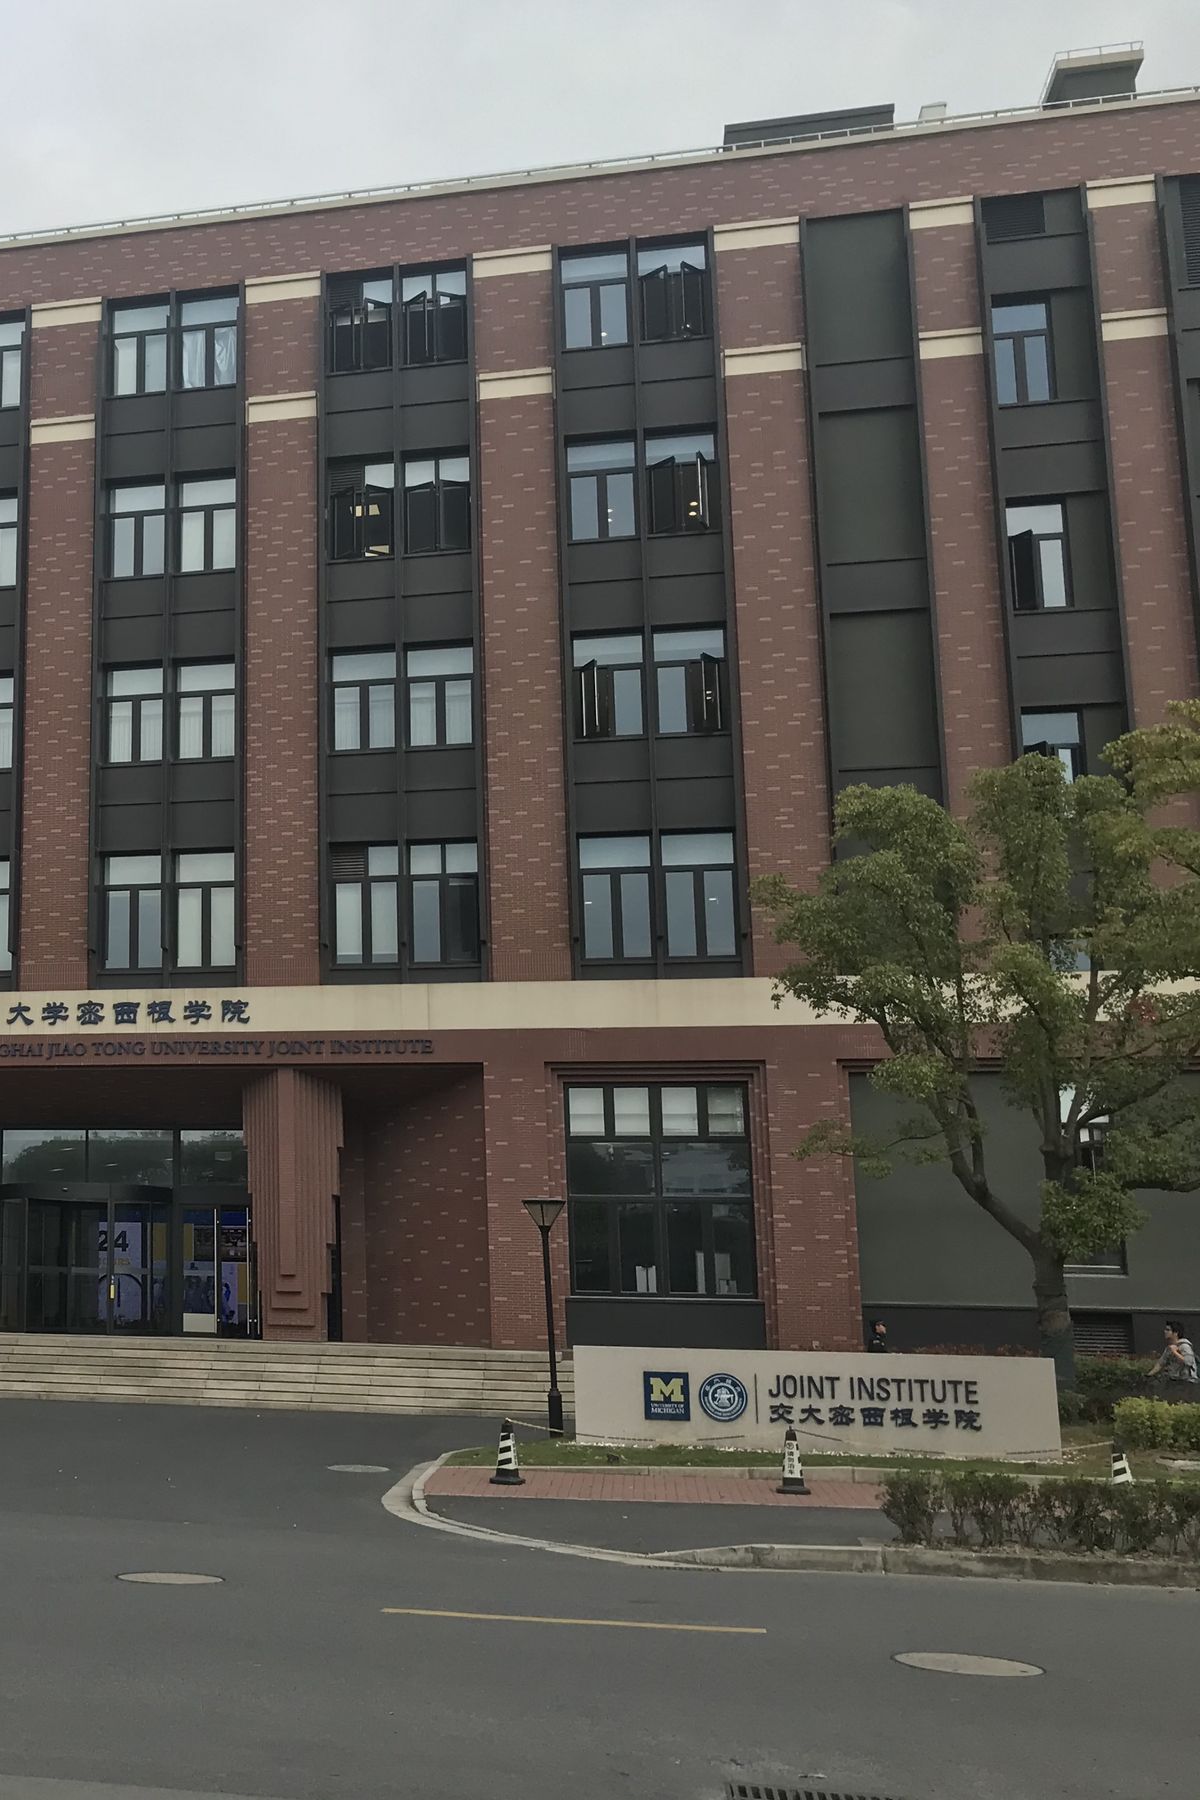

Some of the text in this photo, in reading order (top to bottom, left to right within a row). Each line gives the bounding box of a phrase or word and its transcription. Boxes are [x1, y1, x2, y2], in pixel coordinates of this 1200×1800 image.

[46, 1042, 88, 1061] JIAO
[91, 1041, 147, 1057] TONG
[151, 1040, 264, 1056] UNIVERSITY
[267, 1039, 326, 1059] JOINT
[330, 1038, 433, 1055] INSTITUTE
[98, 1230, 129, 1252] 24
[649, 1377, 685, 1402] M
[768, 1374, 840, 1400] JOINT
[850, 1377, 979, 1405] INSTITUTE
[650, 1407, 685, 1415] MICHIGAN
[769, 1403, 982, 1432] 交大密西根学院
